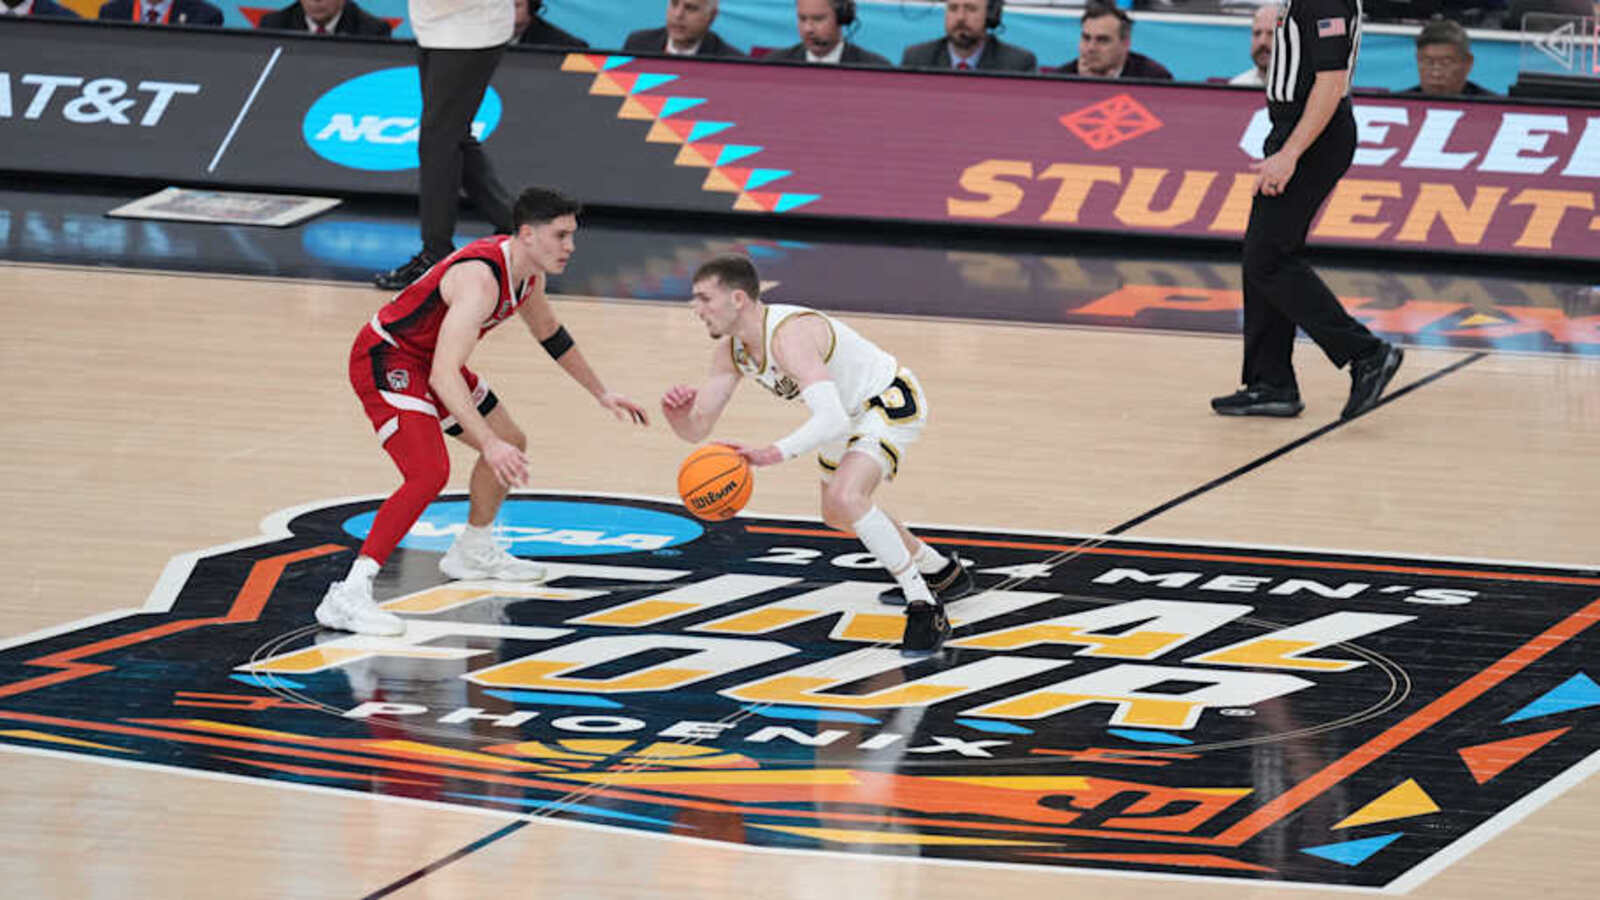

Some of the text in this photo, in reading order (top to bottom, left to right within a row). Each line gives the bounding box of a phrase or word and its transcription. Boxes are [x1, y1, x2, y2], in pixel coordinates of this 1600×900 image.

[314, 113, 486, 144] NC
[1239, 105, 1600, 178] ELE
[747, 547, 1054, 578] 204
[377, 559, 1419, 673] FINAL
[232, 619, 1318, 730] FOUR
[342, 702, 1013, 758] PHOENIX
